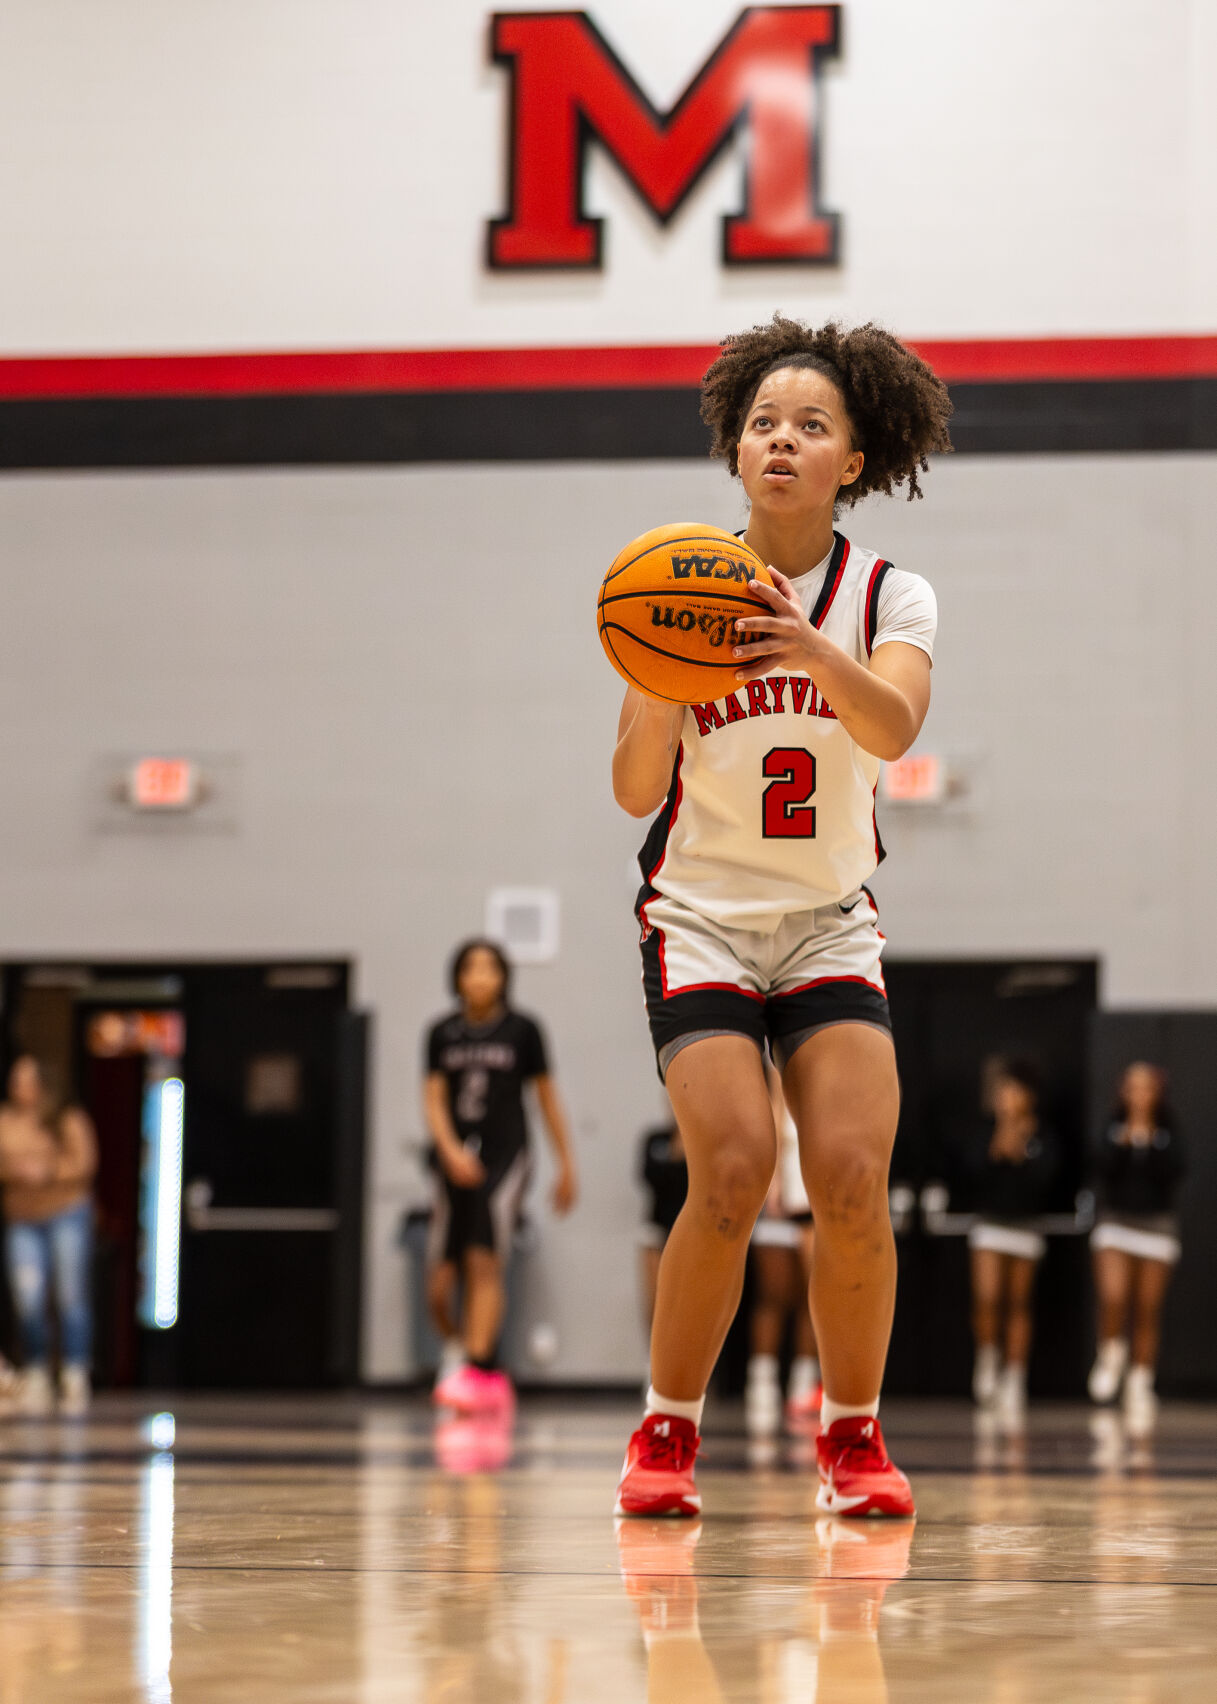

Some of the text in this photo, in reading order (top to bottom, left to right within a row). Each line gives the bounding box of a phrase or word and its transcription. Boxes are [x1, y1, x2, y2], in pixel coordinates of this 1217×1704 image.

[488, 4, 842, 271] M
[671, 554, 756, 585] NCAA
[762, 747, 816, 838] 2
